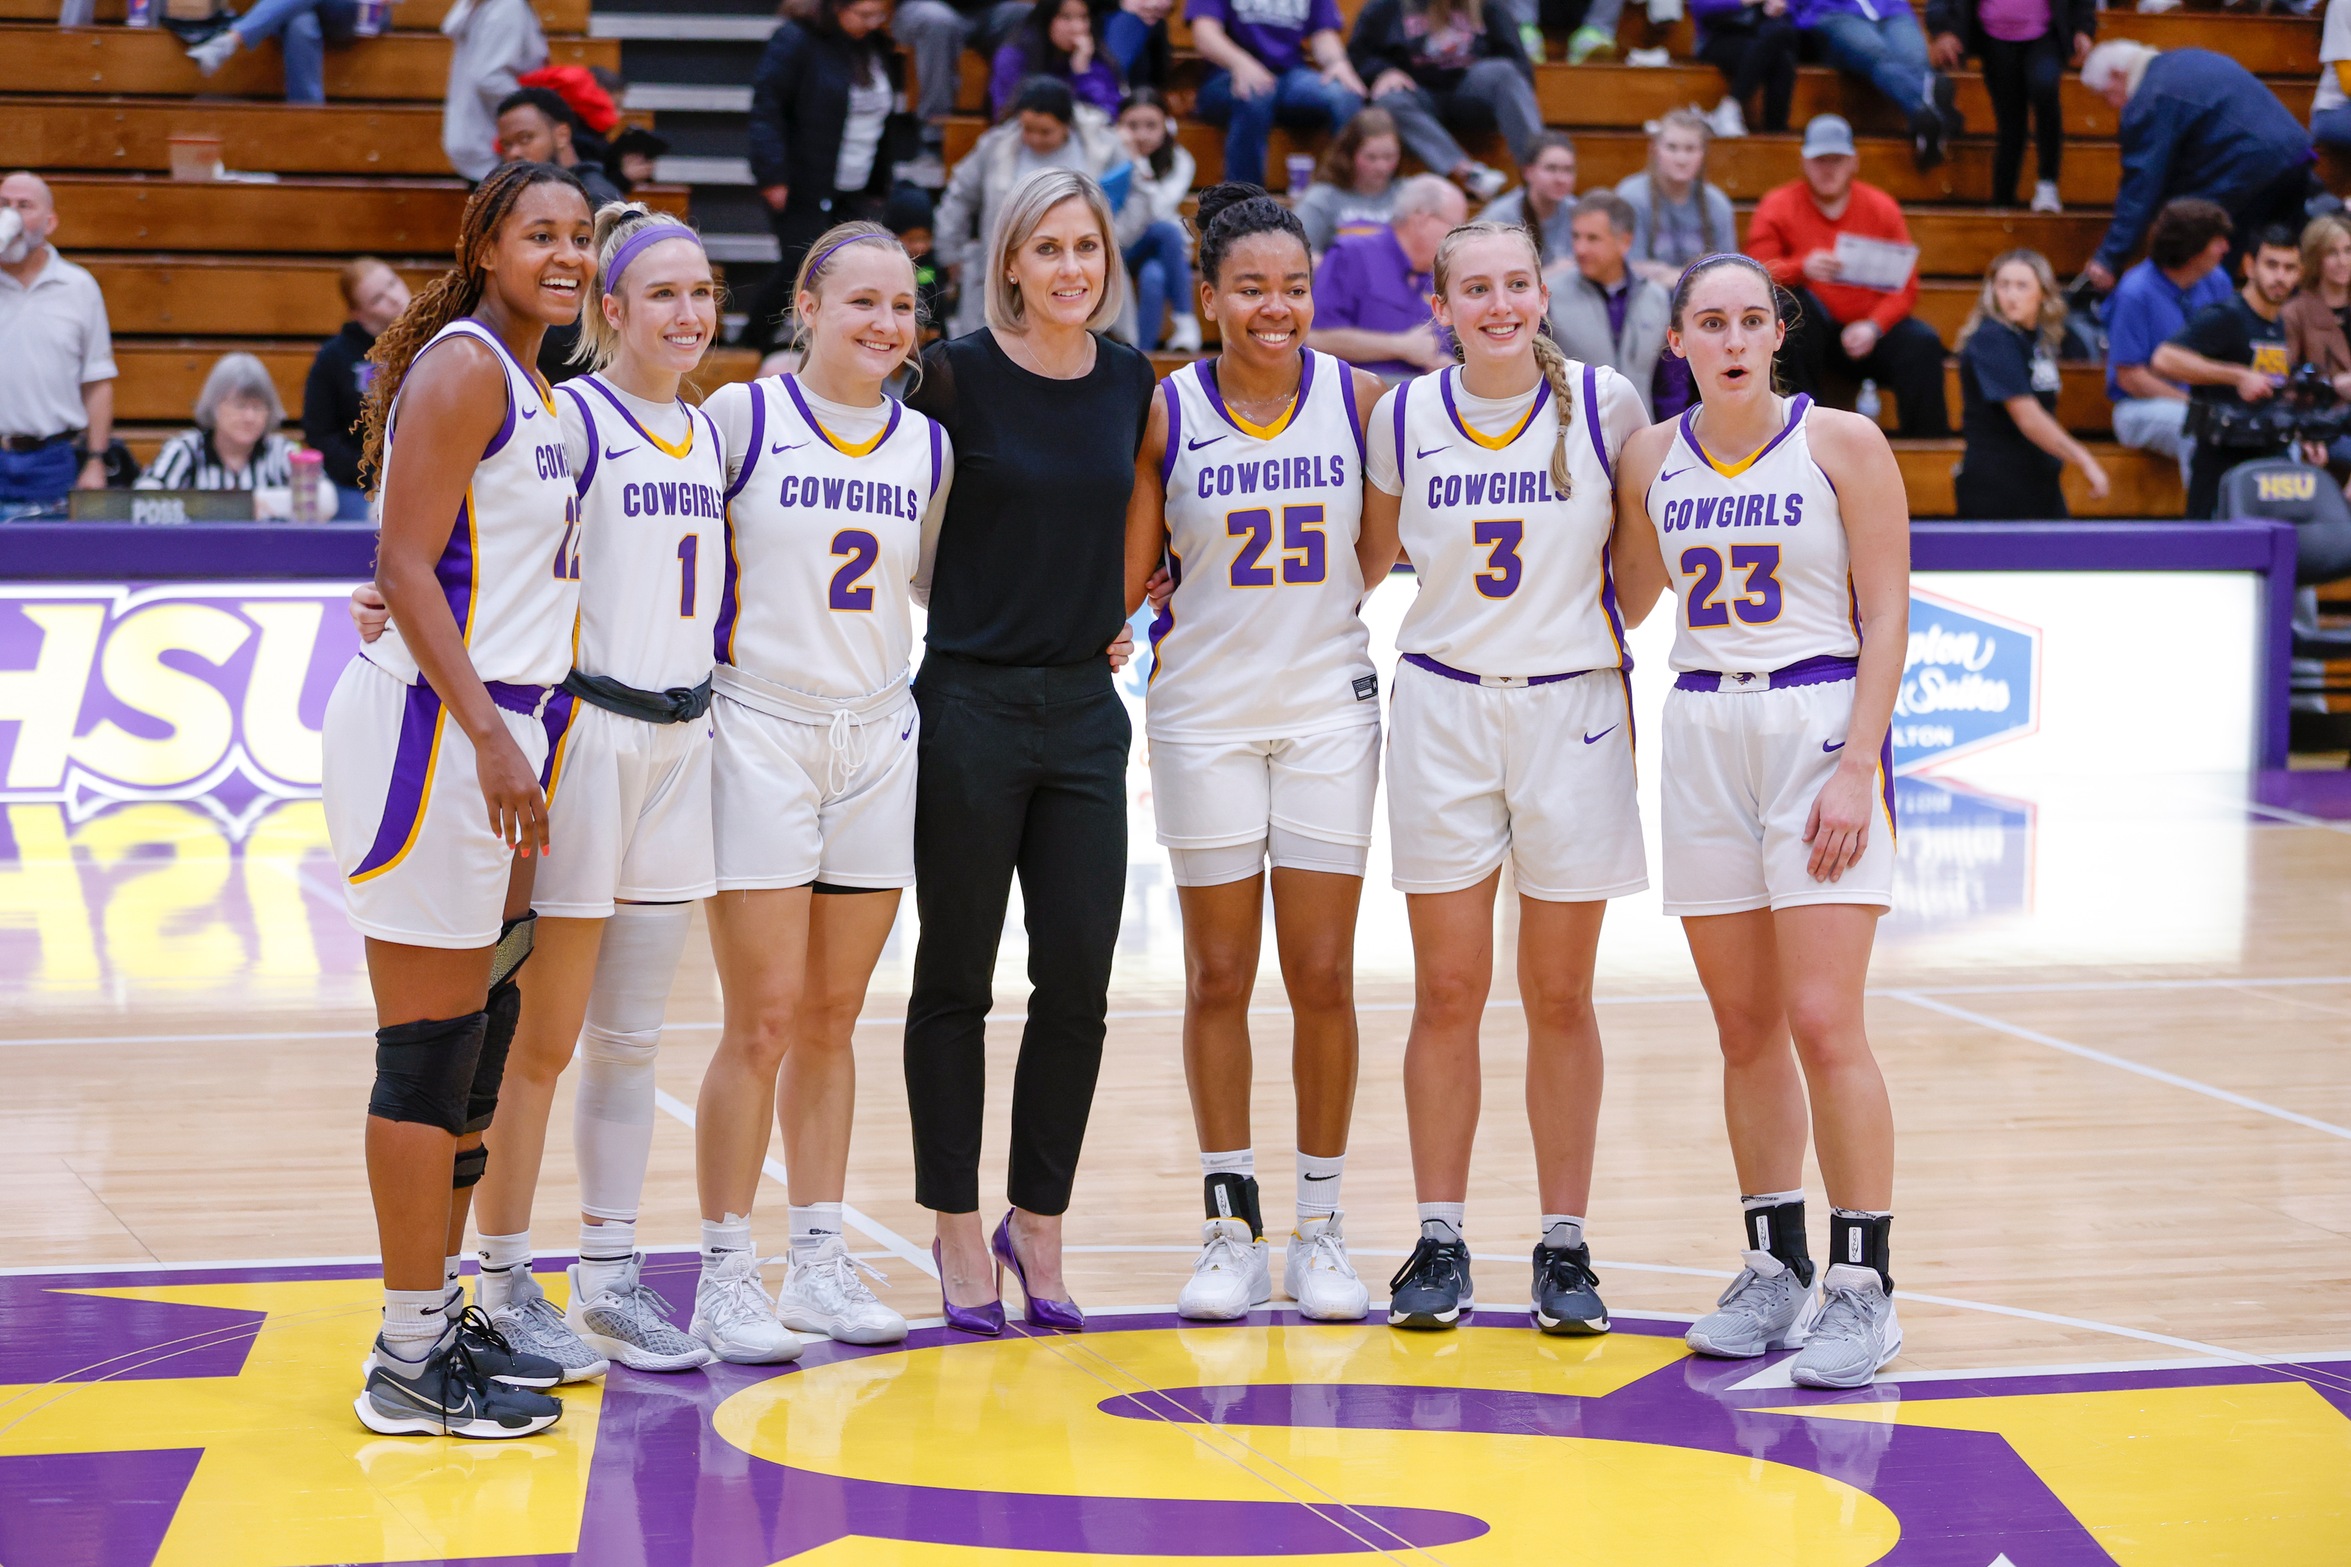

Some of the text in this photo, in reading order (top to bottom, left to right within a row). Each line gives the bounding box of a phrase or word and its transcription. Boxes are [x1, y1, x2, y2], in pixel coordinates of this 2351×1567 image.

[780, 475, 917, 521] COWGIRLS
[1198, 455, 1344, 499] COWGIRLS
[2254, 472, 2317, 500] HSU
[1664, 493, 1803, 533] COWGIRLS
[1225, 502, 1328, 589] 25
[1472, 518, 1524, 600] 3
[677, 532, 699, 619] 1
[828, 527, 880, 613] 2
[1679, 542, 1784, 630] 23
[1905, 624, 1996, 671] pton
[1904, 667, 2010, 713] Suites
[1893, 725, 1954, 747] LTON
[1851, 1228, 1859, 1261] DONJOY
